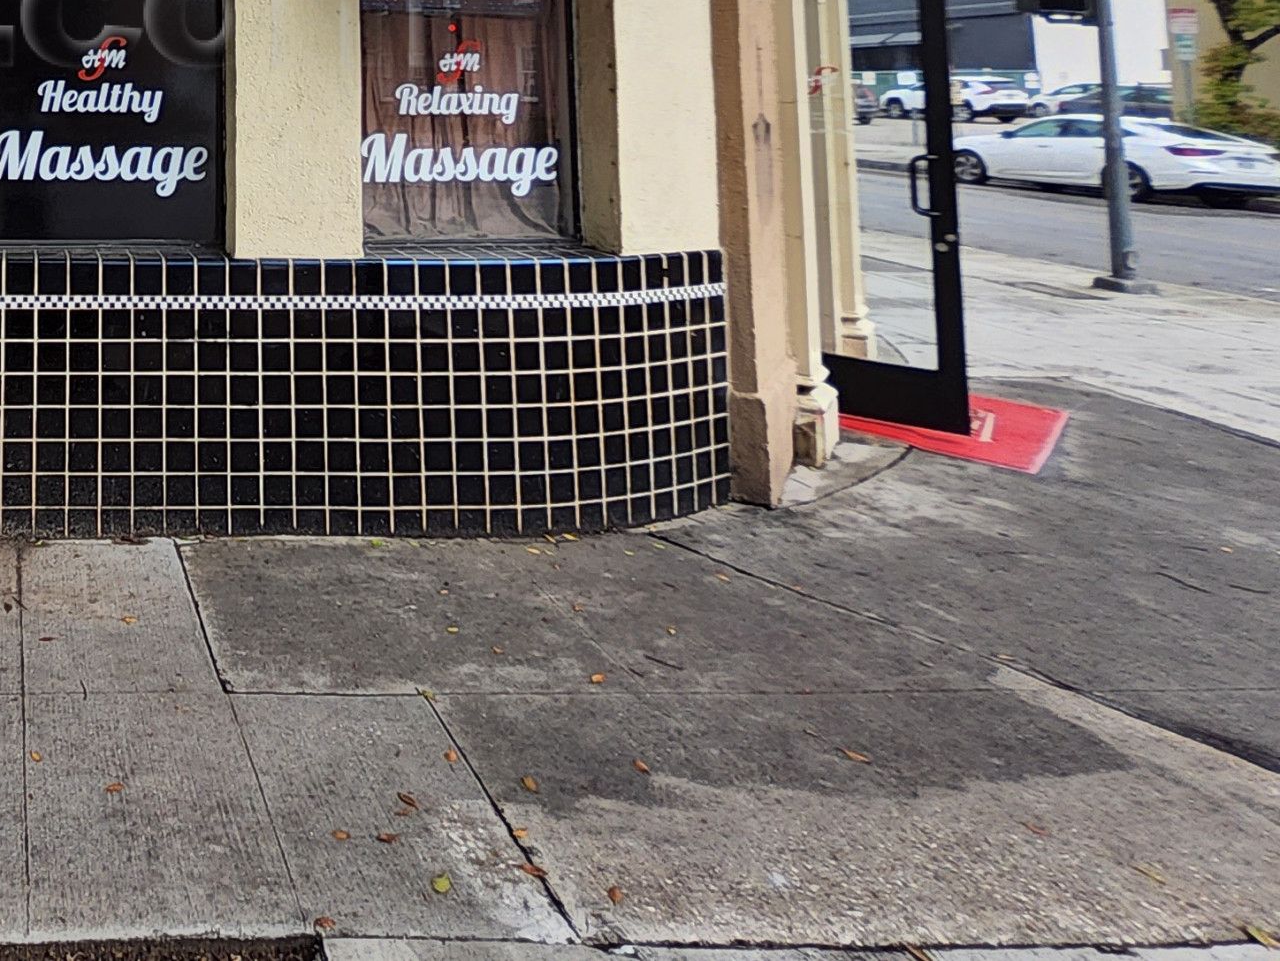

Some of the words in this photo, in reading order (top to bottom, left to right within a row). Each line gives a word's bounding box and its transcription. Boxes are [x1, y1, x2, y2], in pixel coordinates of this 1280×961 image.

[38, 81, 163, 122] Healthy
[395, 84, 519, 124] Relaxing
[361, 132, 558, 196] Massage
